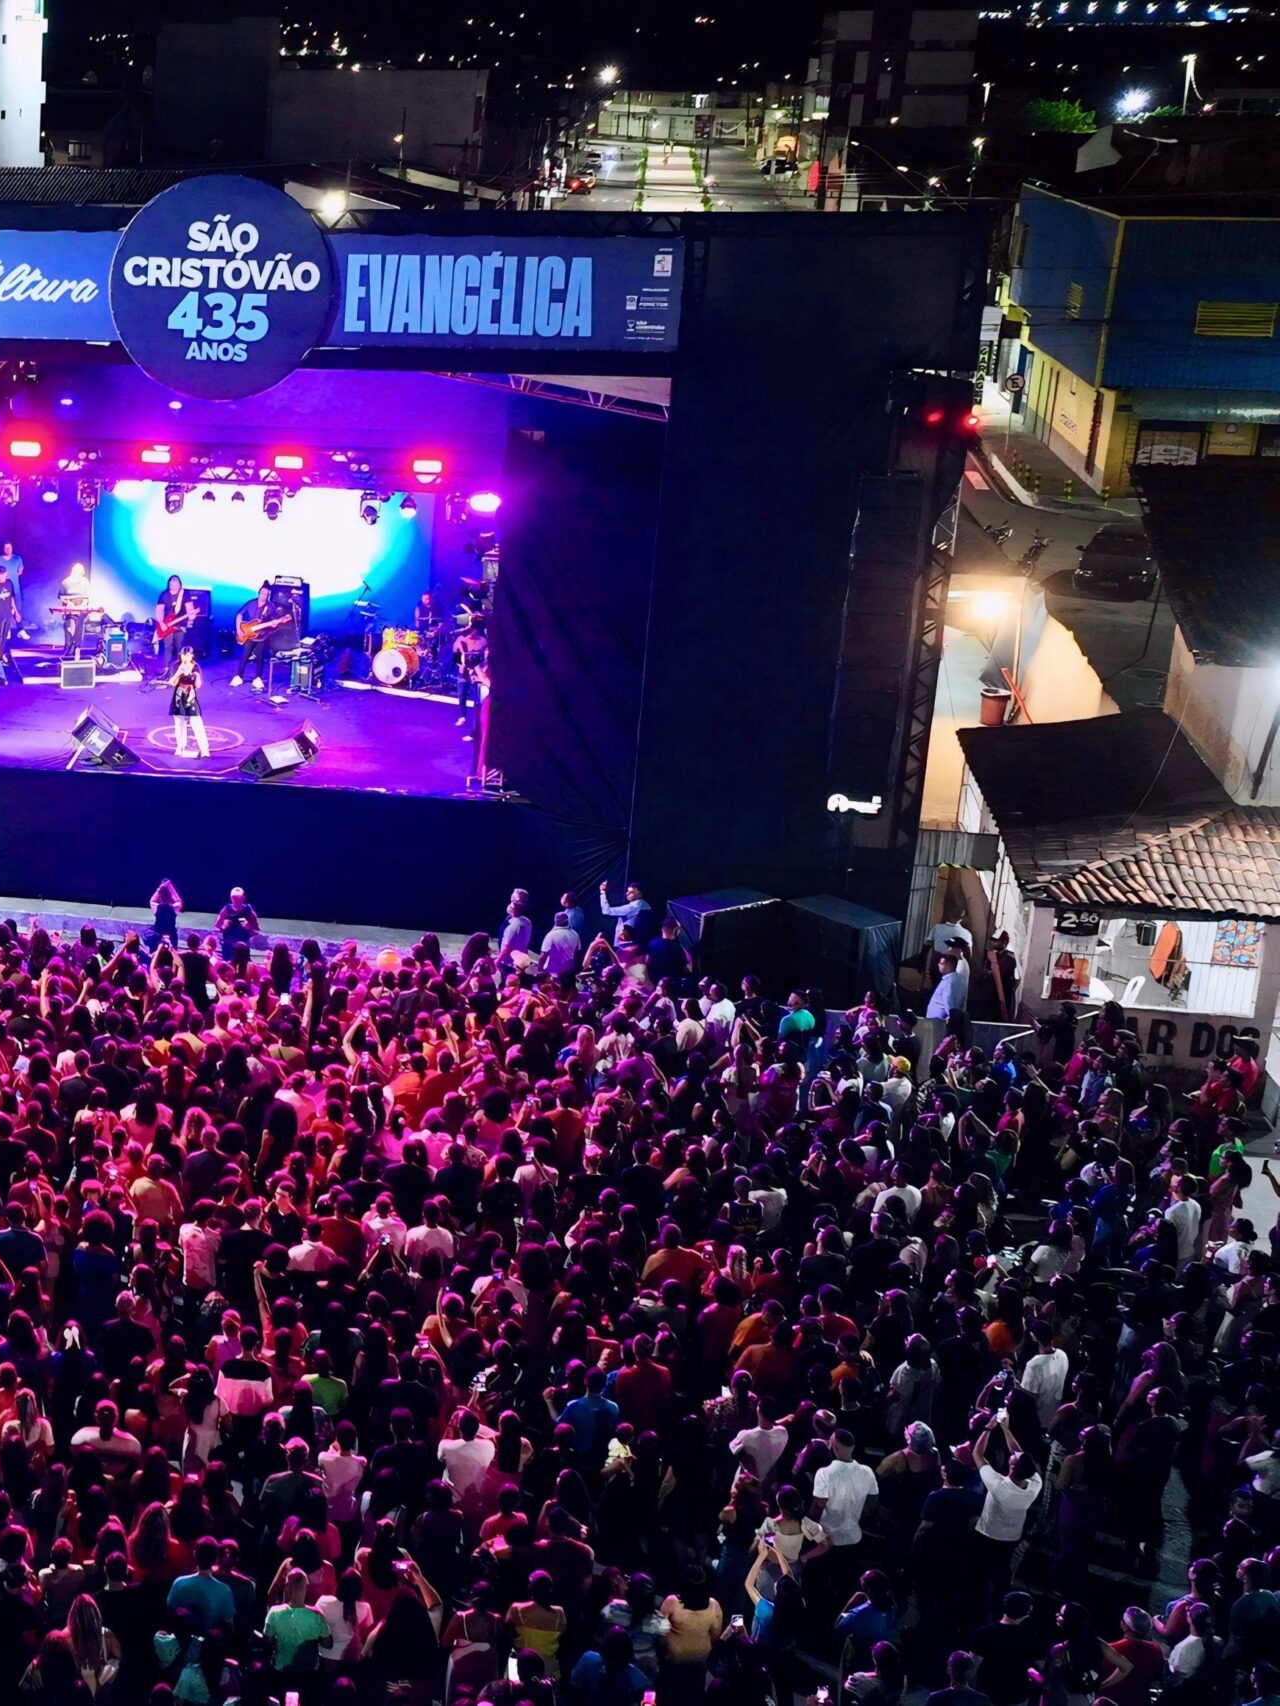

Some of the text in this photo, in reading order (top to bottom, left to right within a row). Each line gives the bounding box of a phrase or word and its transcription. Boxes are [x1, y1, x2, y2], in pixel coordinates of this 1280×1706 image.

[186, 214, 259, 252] SÃO
[123, 252, 321, 291] CRISTÓVÃO
[344, 251, 592, 337] EVANGÉLICA
[167, 291, 270, 342] 435
[185, 341, 248, 362] ANOS
